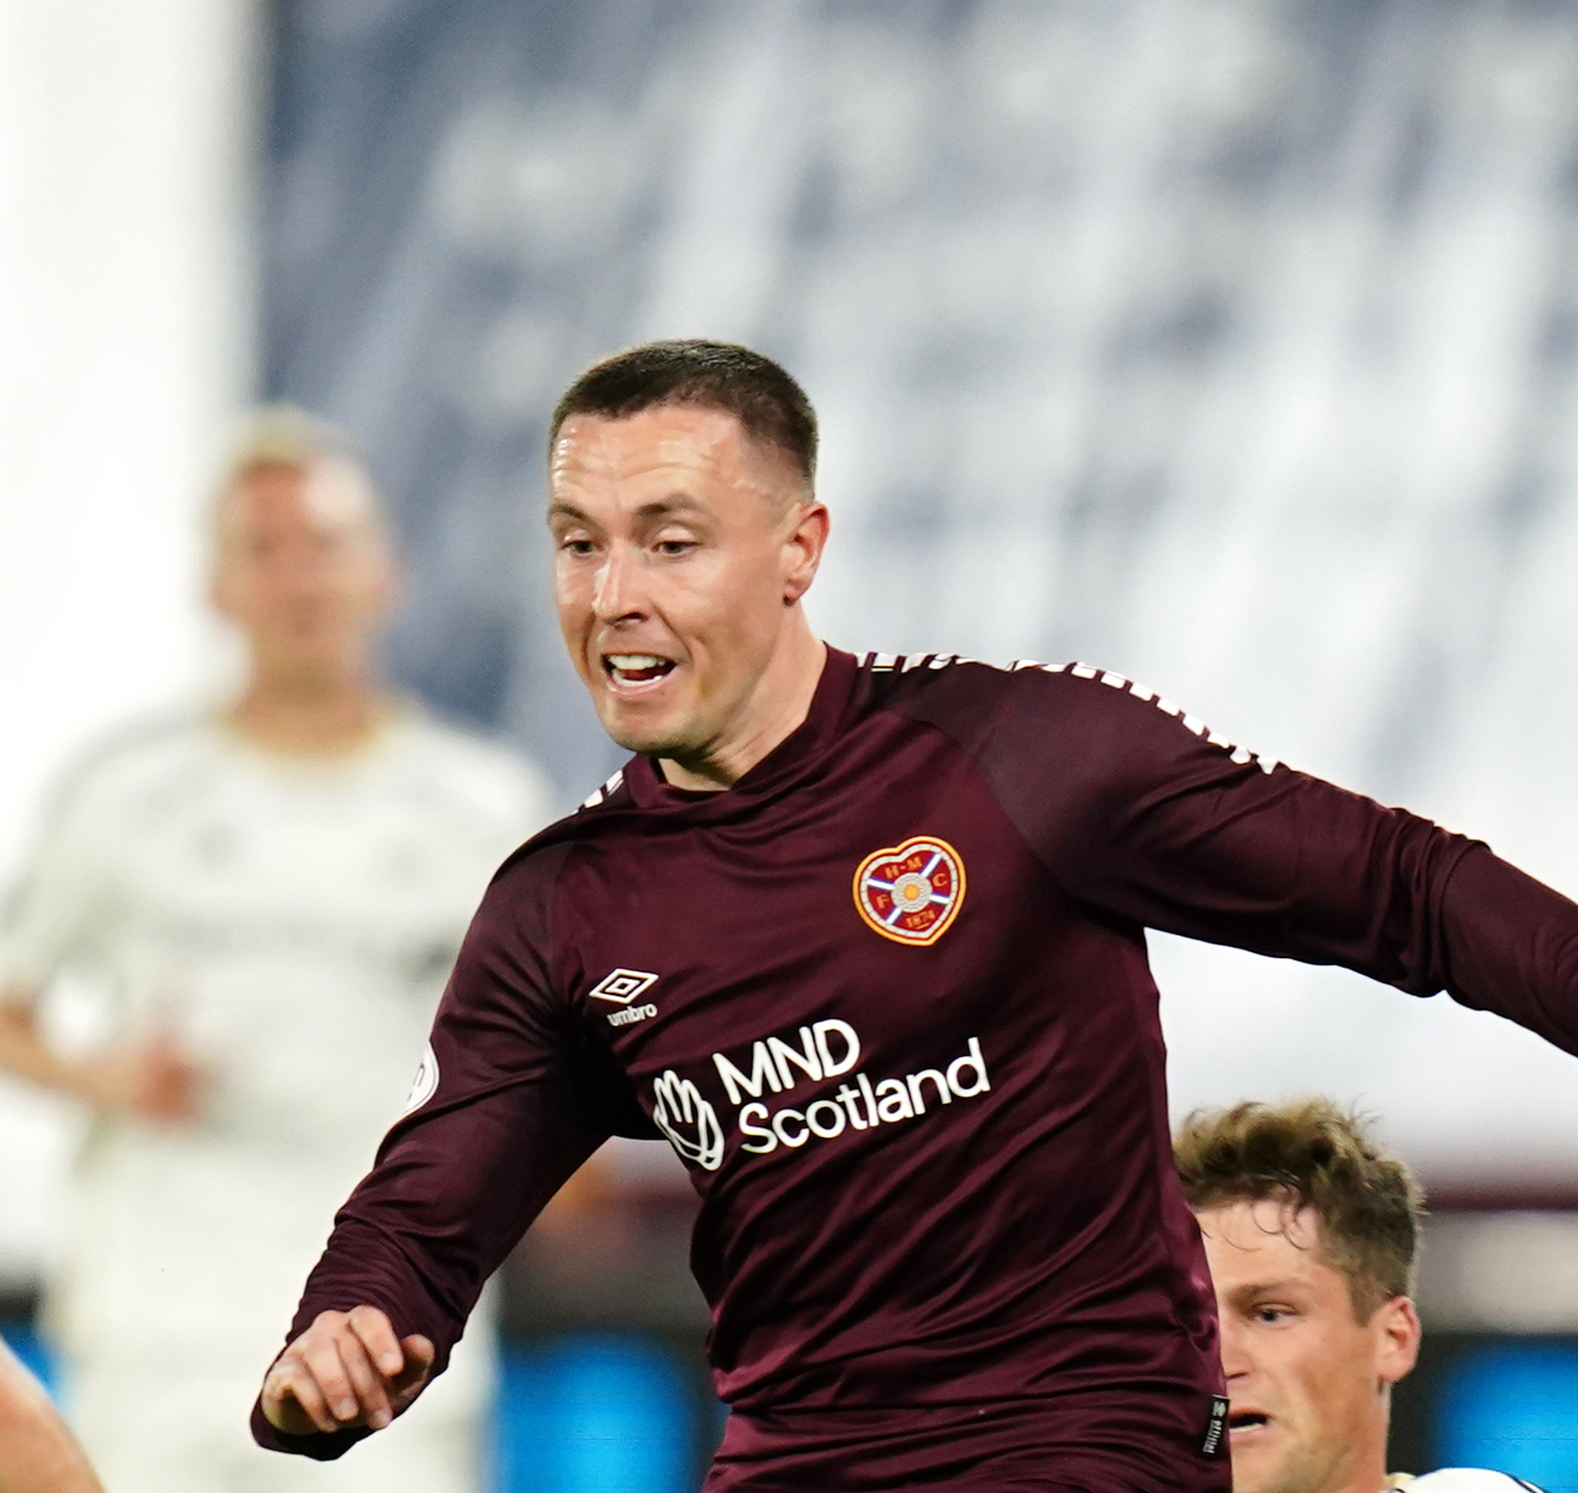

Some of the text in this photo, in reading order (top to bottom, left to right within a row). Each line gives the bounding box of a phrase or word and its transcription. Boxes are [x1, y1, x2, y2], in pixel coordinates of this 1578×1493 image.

[606, 1001, 658, 1027] umbro
[712, 1018, 861, 1105] MND
[737, 1036, 992, 1154] Scotland
